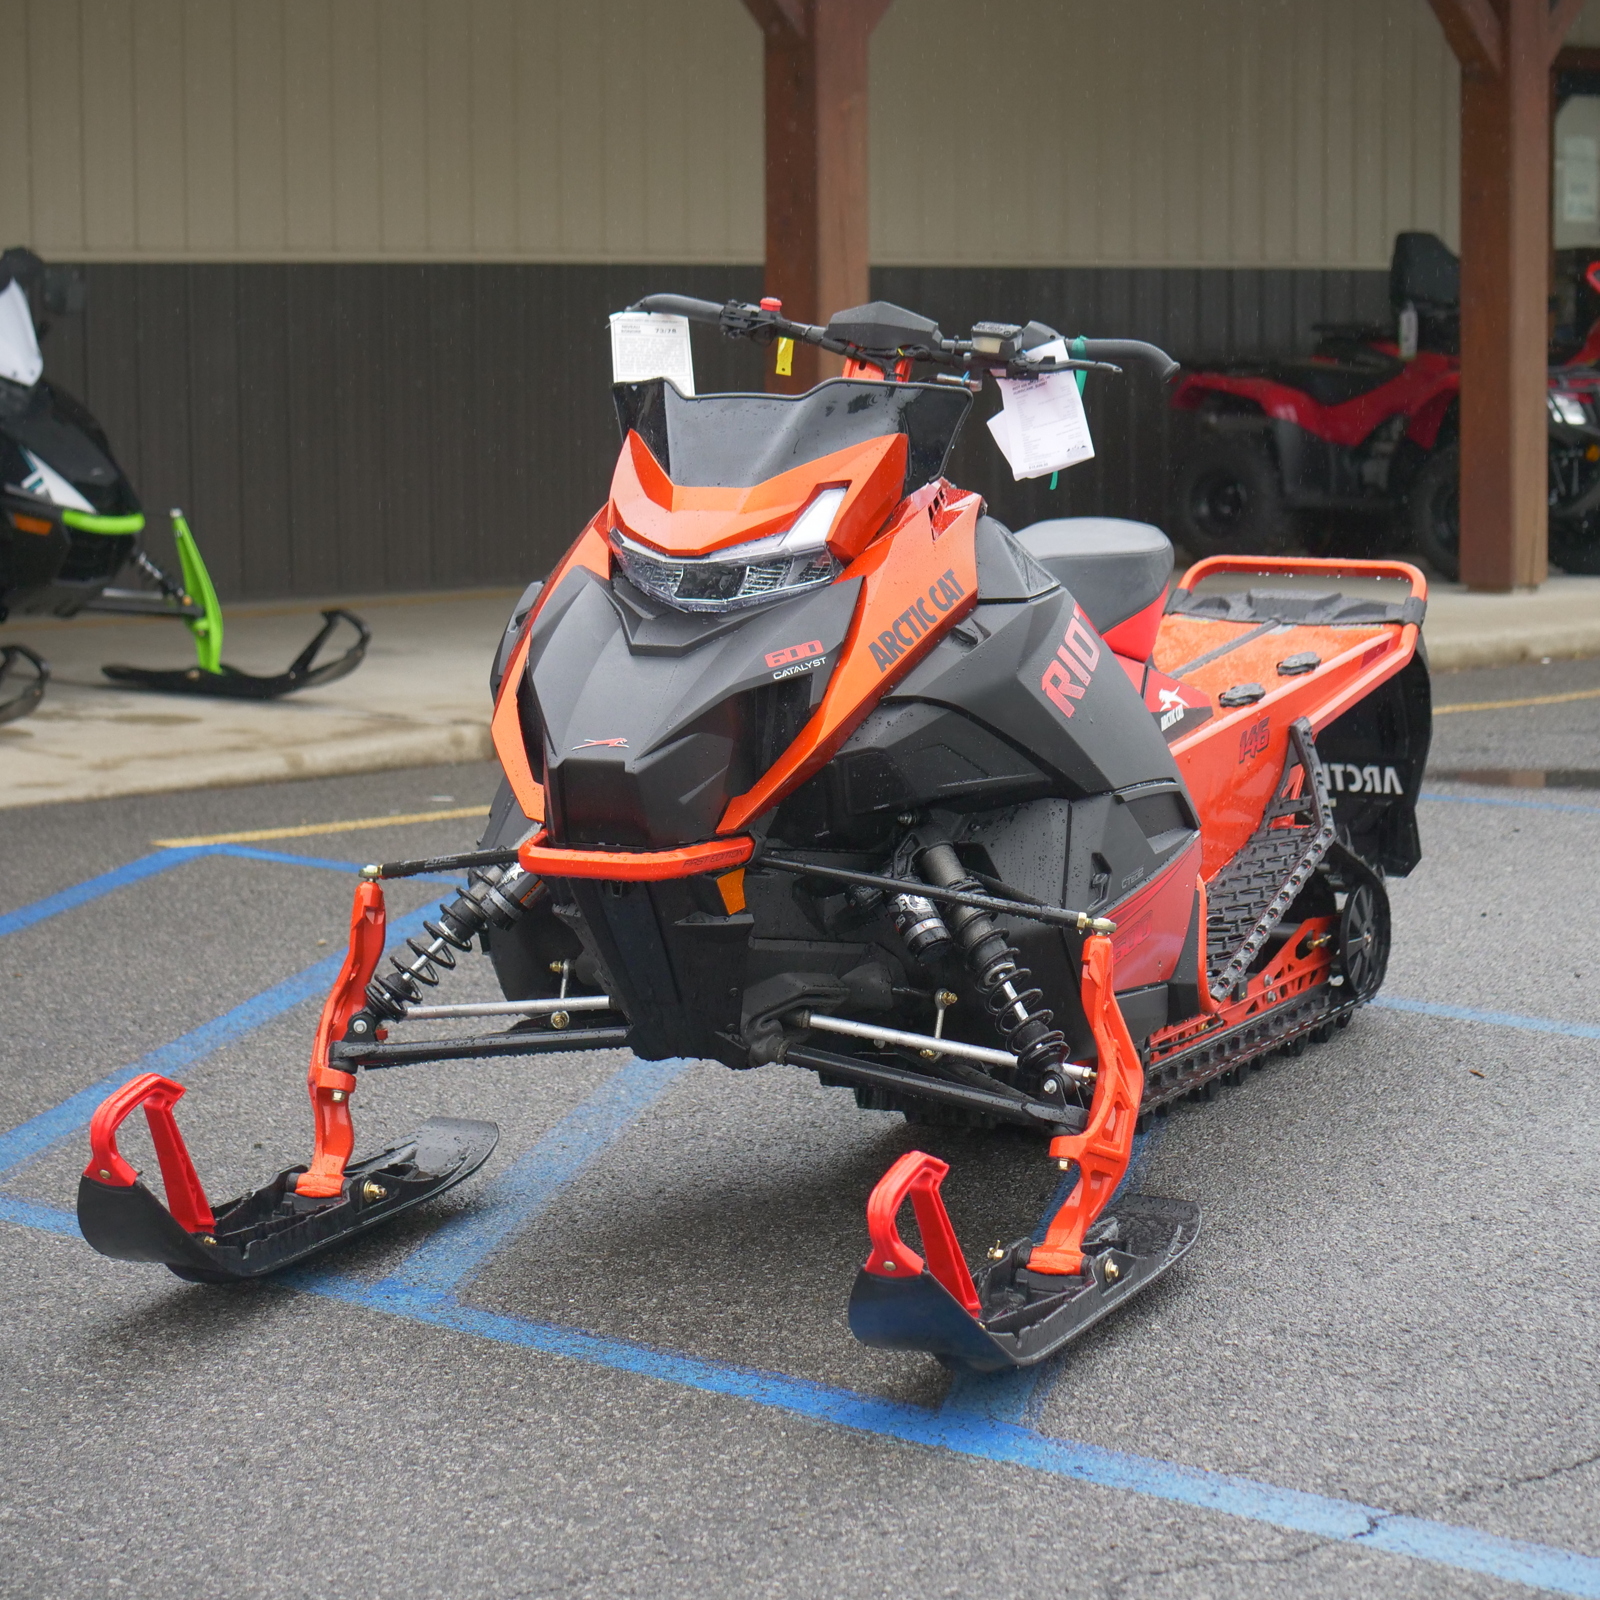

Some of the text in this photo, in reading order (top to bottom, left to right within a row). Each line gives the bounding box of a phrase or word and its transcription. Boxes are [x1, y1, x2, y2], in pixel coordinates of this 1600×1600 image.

[868, 568, 966, 673] ARCTIC CAT
[764, 639, 824, 668] 600
[773, 656, 827, 680] CATALYST
[1239, 716, 1270, 764] 146
[682, 849, 746, 868] FIRST EDITION
